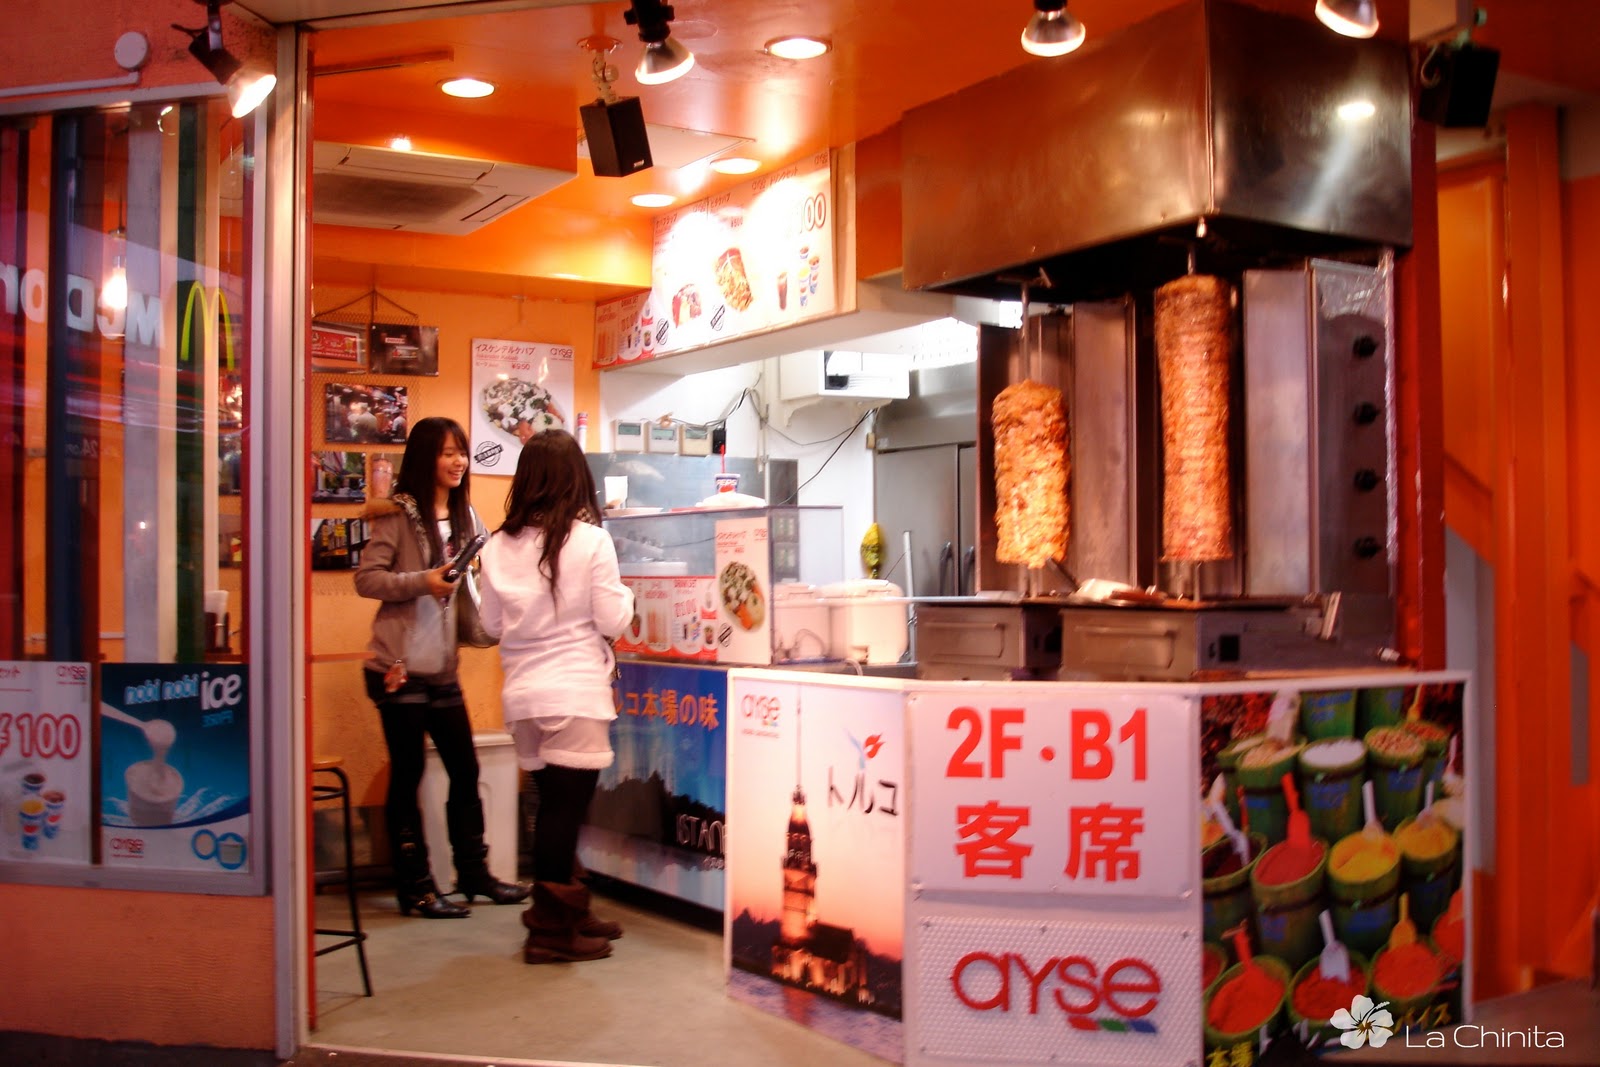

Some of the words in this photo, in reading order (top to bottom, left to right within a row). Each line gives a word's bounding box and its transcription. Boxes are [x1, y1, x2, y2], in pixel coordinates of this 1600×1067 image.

[201, 671, 242, 710] ice
[827, 766, 898, 816] トルコ
[676, 813, 726, 855] ISTAN
[954, 800, 1145, 883] 客席
[951, 951, 1161, 1018] ayse
